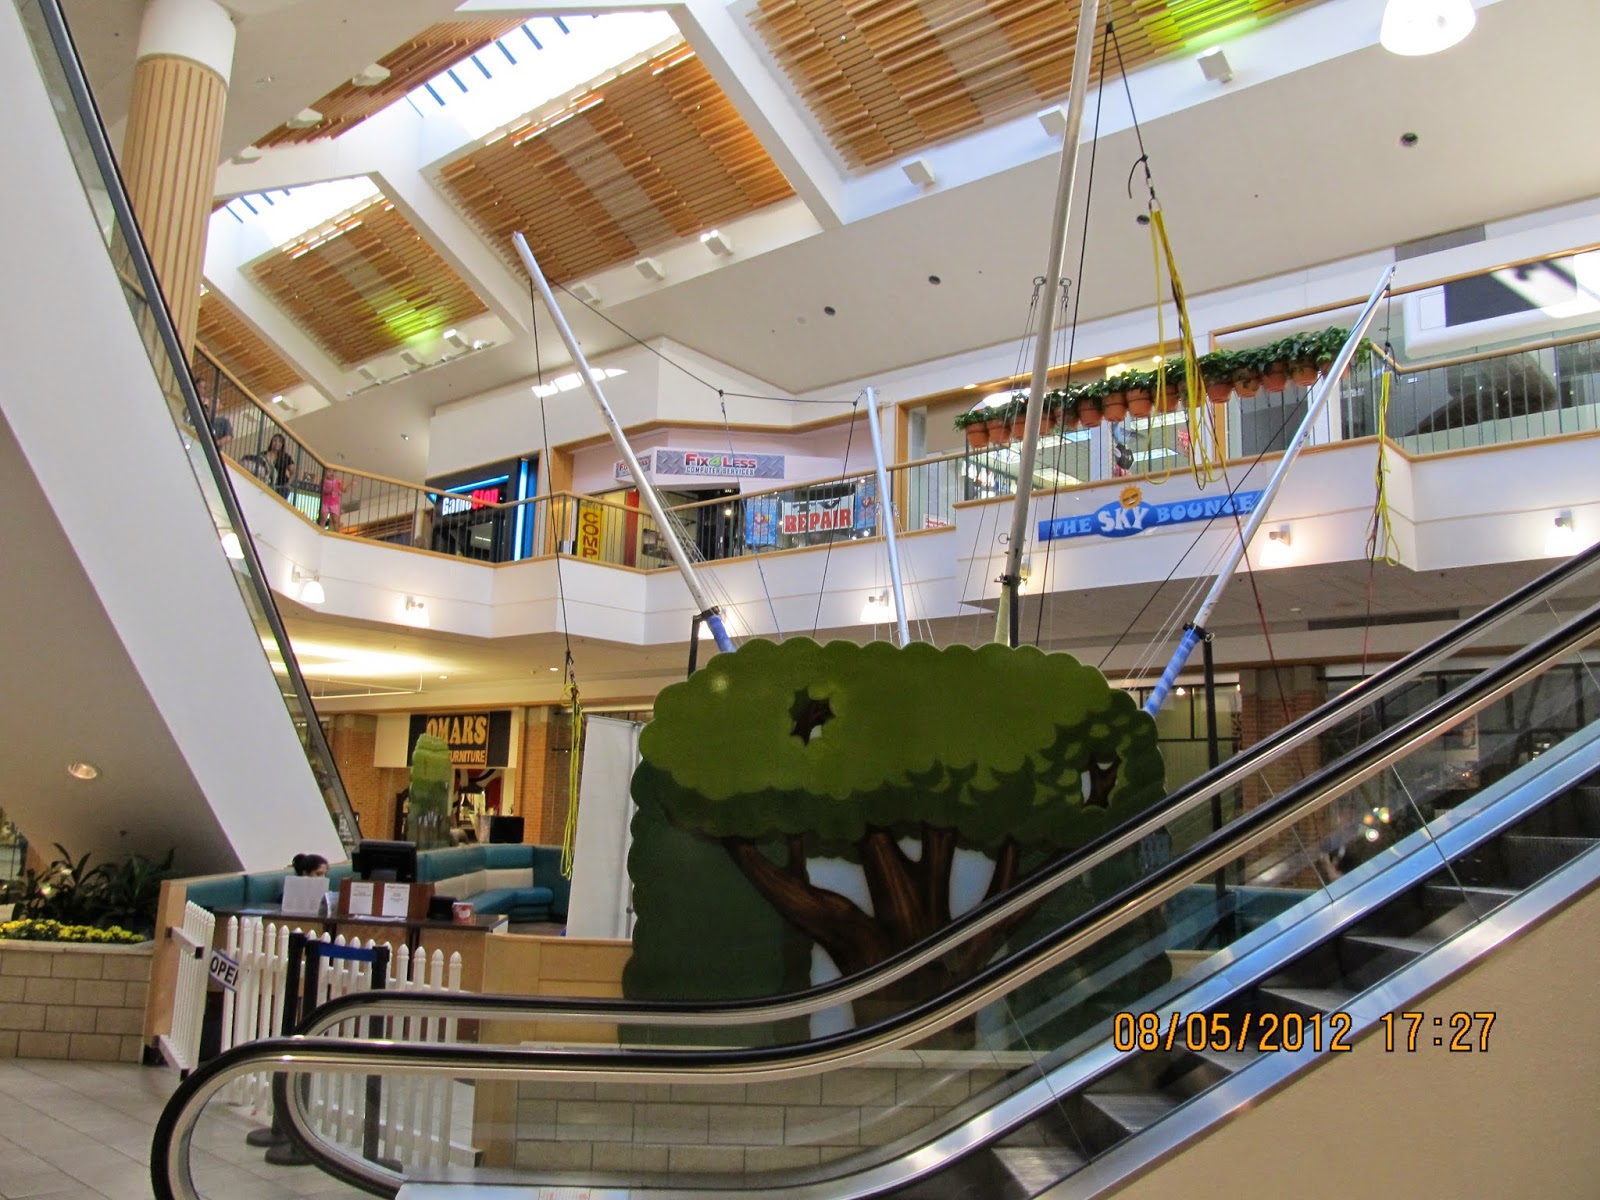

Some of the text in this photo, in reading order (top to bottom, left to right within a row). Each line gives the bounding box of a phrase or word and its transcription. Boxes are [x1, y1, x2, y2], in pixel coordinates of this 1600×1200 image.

[686, 466, 754, 476] COMPUTER SERVICES
[784, 508, 852, 533] REPAIR
[1051, 495, 1255, 538] THE SKY BOUNCE
[426, 715, 487, 745] OMAR'S
[449, 750, 486, 762] URNITURE
